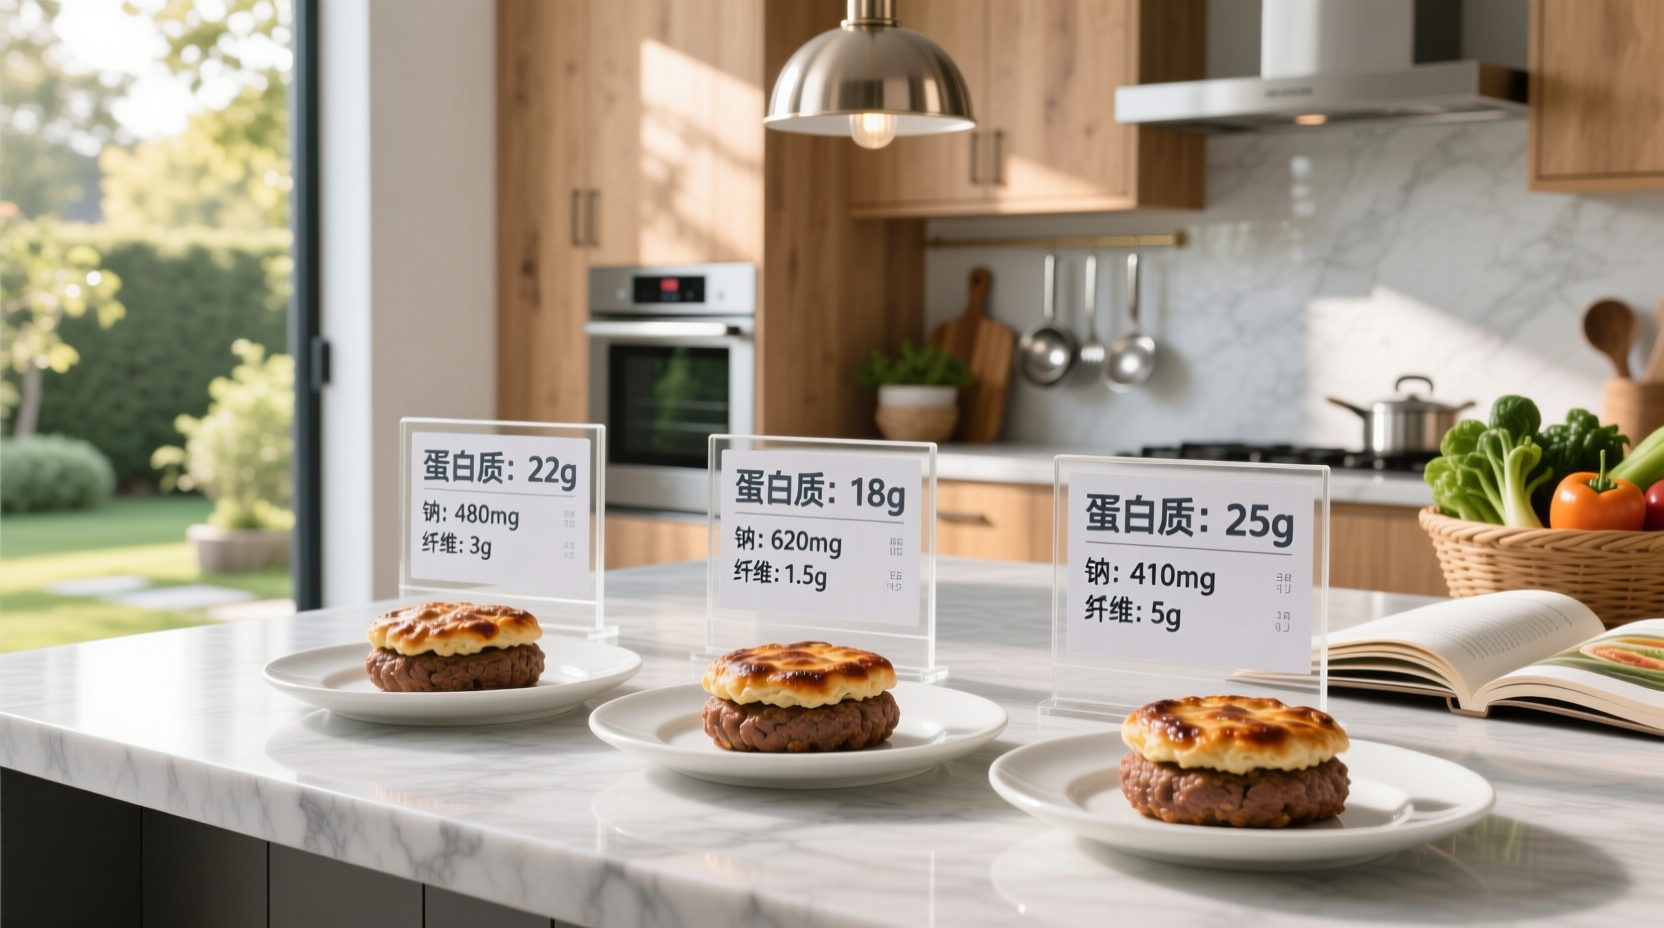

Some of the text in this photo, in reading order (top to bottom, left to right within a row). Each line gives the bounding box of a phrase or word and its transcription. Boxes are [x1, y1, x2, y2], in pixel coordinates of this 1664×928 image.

[528, 456, 576, 491] 22g
[851, 477, 905, 516] 18g
[455, 504, 519, 531] 480mg
[1226, 503, 1293, 548] 25g
[470, 536, 491, 560] 3g
[771, 529, 841, 559] 620mg
[1129, 562, 1216, 596] 410mg
[1151, 601, 1181, 632] 5g
